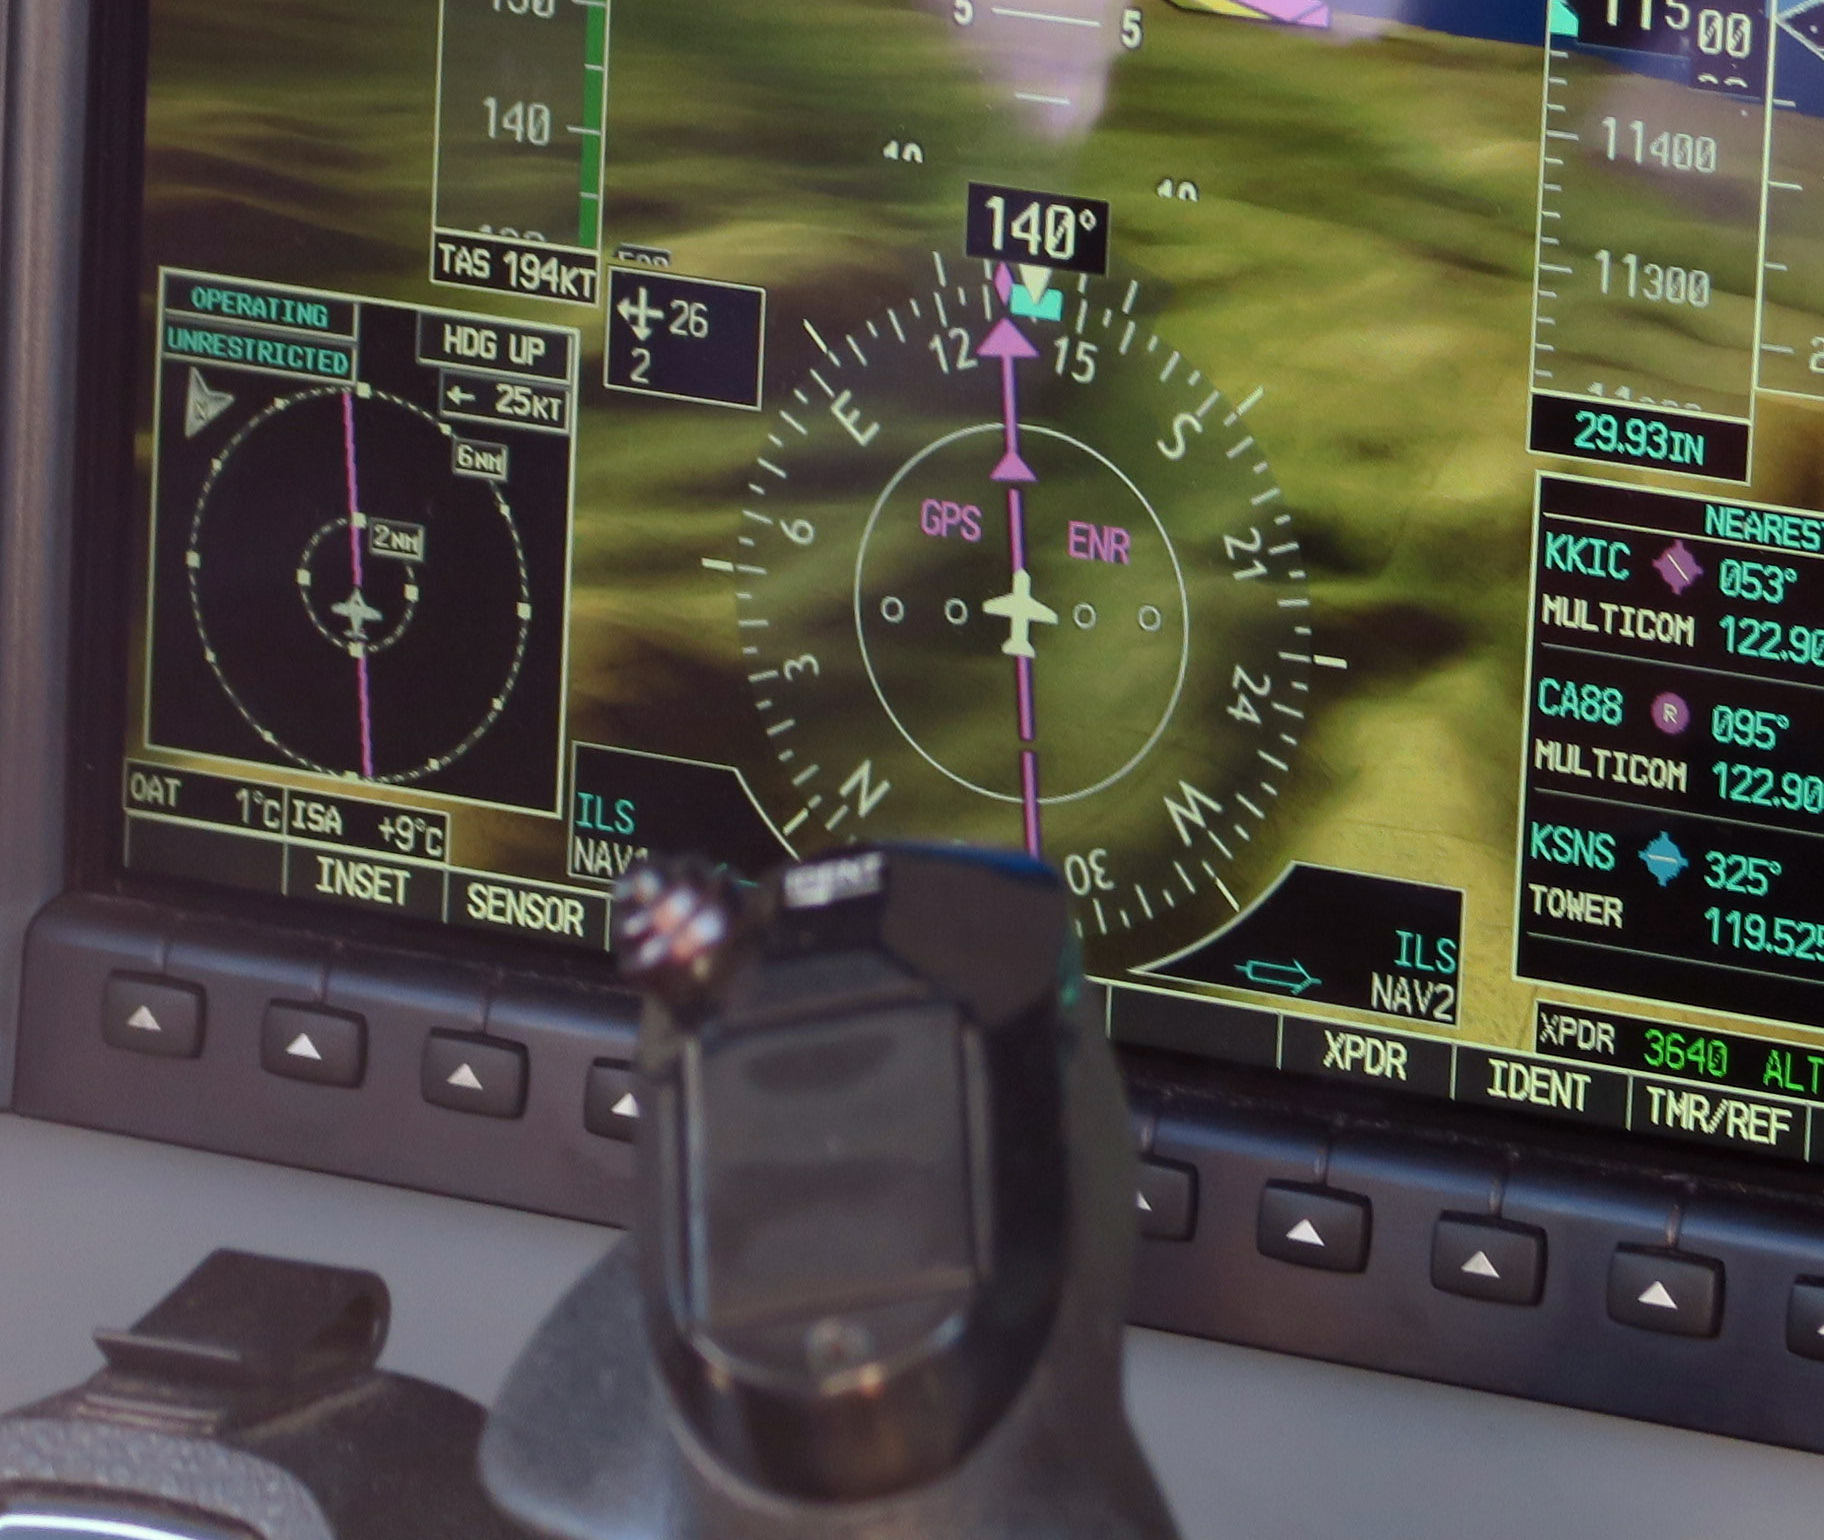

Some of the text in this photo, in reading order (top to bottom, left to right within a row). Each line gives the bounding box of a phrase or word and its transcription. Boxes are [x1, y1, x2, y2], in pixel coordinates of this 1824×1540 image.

[192, 286, 327, 329] OPERATING
[168, 327, 348, 375] UNRESTRICTED
[443, 323, 545, 364] HDG UP
[1545, 532, 1631, 581] KKIC
[1542, 593, 1694, 648] MULTICOM
[1539, 678, 1623, 726] CA88
[1535, 739, 1686, 793] MULTICOM
[577, 792, 634, 834] ILS
[1530, 822, 1615, 871] KSNS
[316, 856, 410, 907] INSET
[1529, 883, 1622, 928] TOWER
[467, 883, 584, 937] SENSOR
[1395, 930, 1456, 975] ILS
[1371, 971, 1455, 1022] NAV2
[1322, 1031, 1408, 1081] XPDR
[1540, 1011, 1615, 1055] XPDR
[1645, 1029, 1729, 1079] 3640
[1488, 1058, 1590, 1113] IDENT
[1646, 1087, 1791, 1147] TMR/REF
